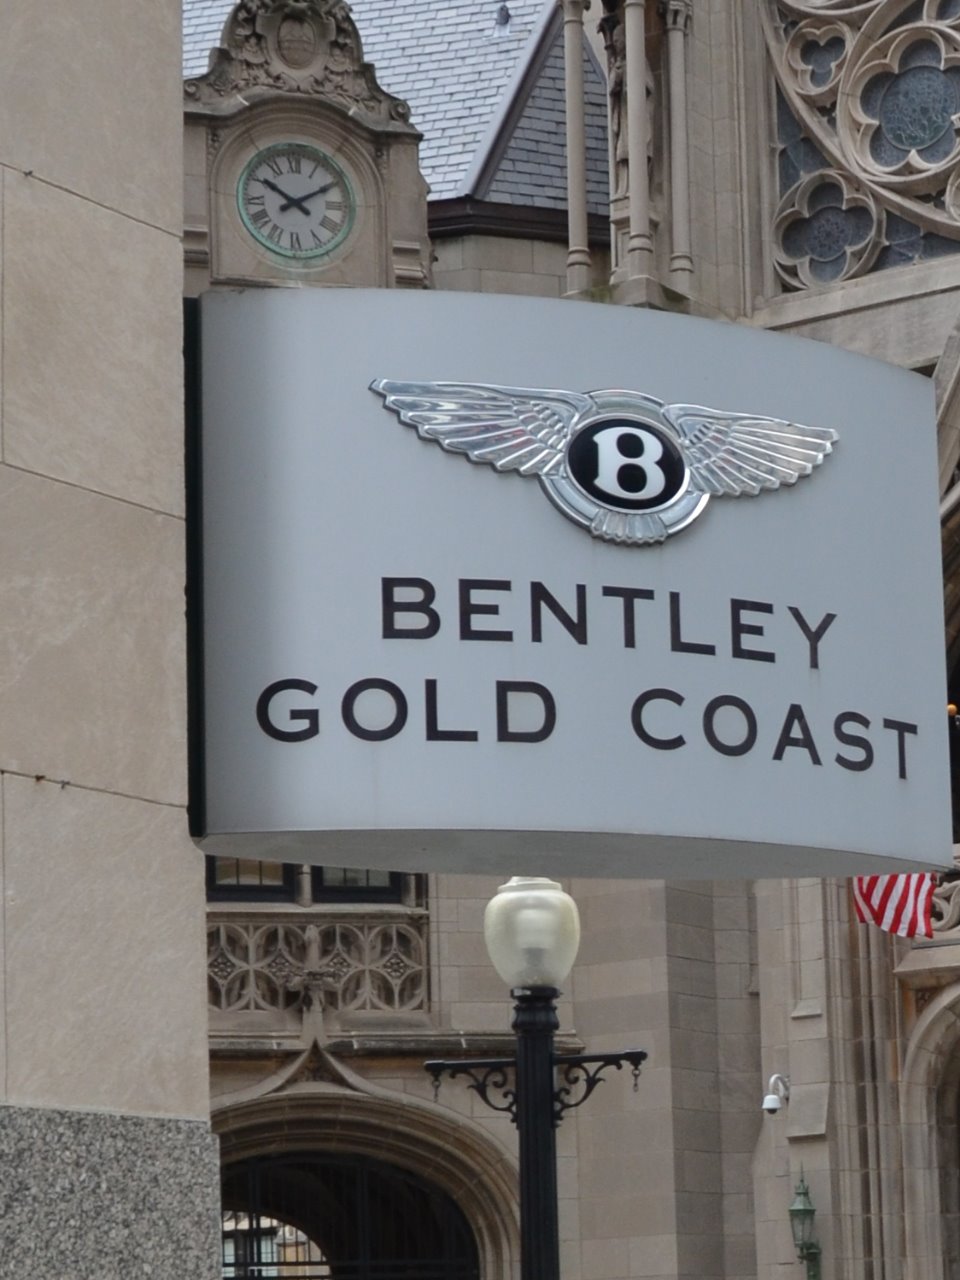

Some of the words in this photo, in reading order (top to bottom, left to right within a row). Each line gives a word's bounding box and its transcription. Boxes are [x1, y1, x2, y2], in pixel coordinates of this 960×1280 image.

[594, 426, 666, 501] B
[381, 576, 838, 670] BENTLEY
[255, 677, 558, 744] GOLD
[630, 687, 919, 780] COAST
